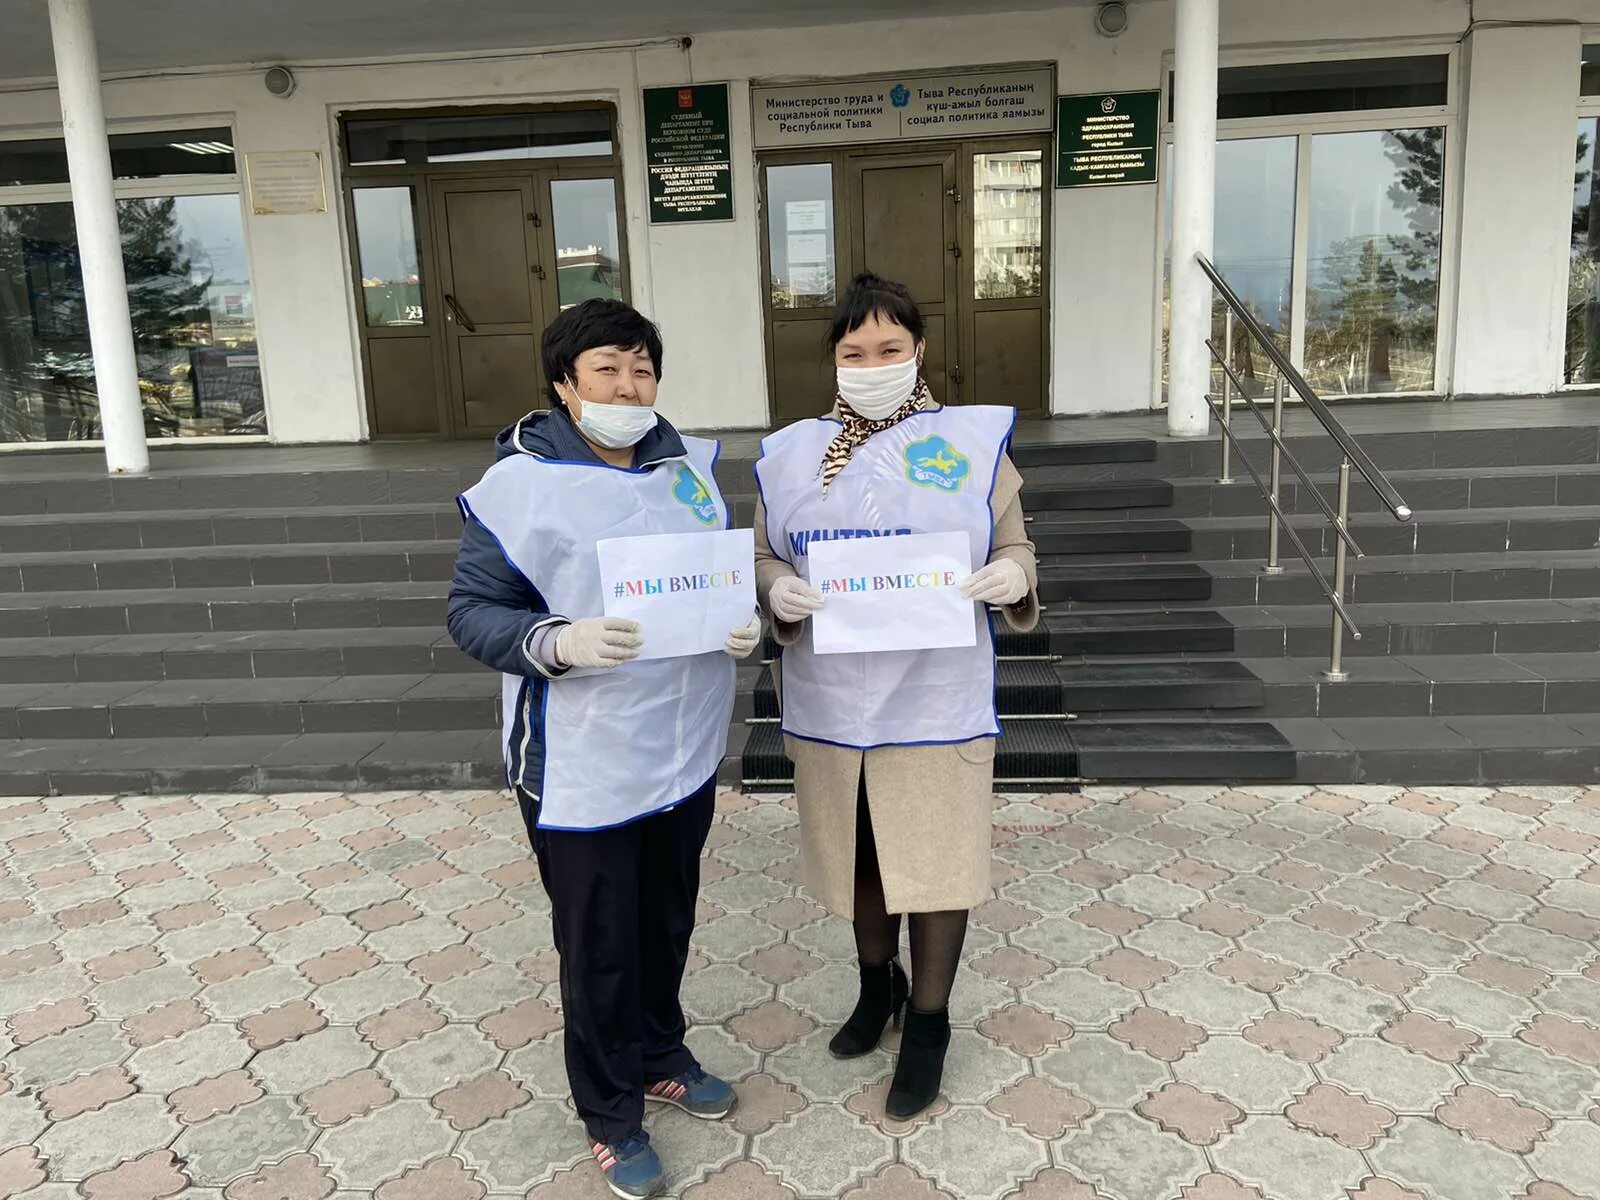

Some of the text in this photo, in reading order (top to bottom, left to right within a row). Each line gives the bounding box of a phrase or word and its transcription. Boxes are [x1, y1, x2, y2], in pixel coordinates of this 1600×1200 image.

[917, 83, 1034, 98] Тыва Республиканың
[766, 94, 884, 109] Министерство труда и
[927, 97, 1025, 112] күш-ажыл болгаш
[767, 107, 883, 122] социальной политики
[907, 108, 1045, 126] социал политика яамызы
[1086, 115, 1130, 123] МИНИСТЕРСТВО
[780, 119, 872, 134] Республики Тыва
[651, 135, 689, 144] РОССИЙСКОЙ
[614, 570, 742, 598] #МЫ ВМЕСТЕ
[821, 571, 956, 594] #МЫ ВМЕСТЕ
